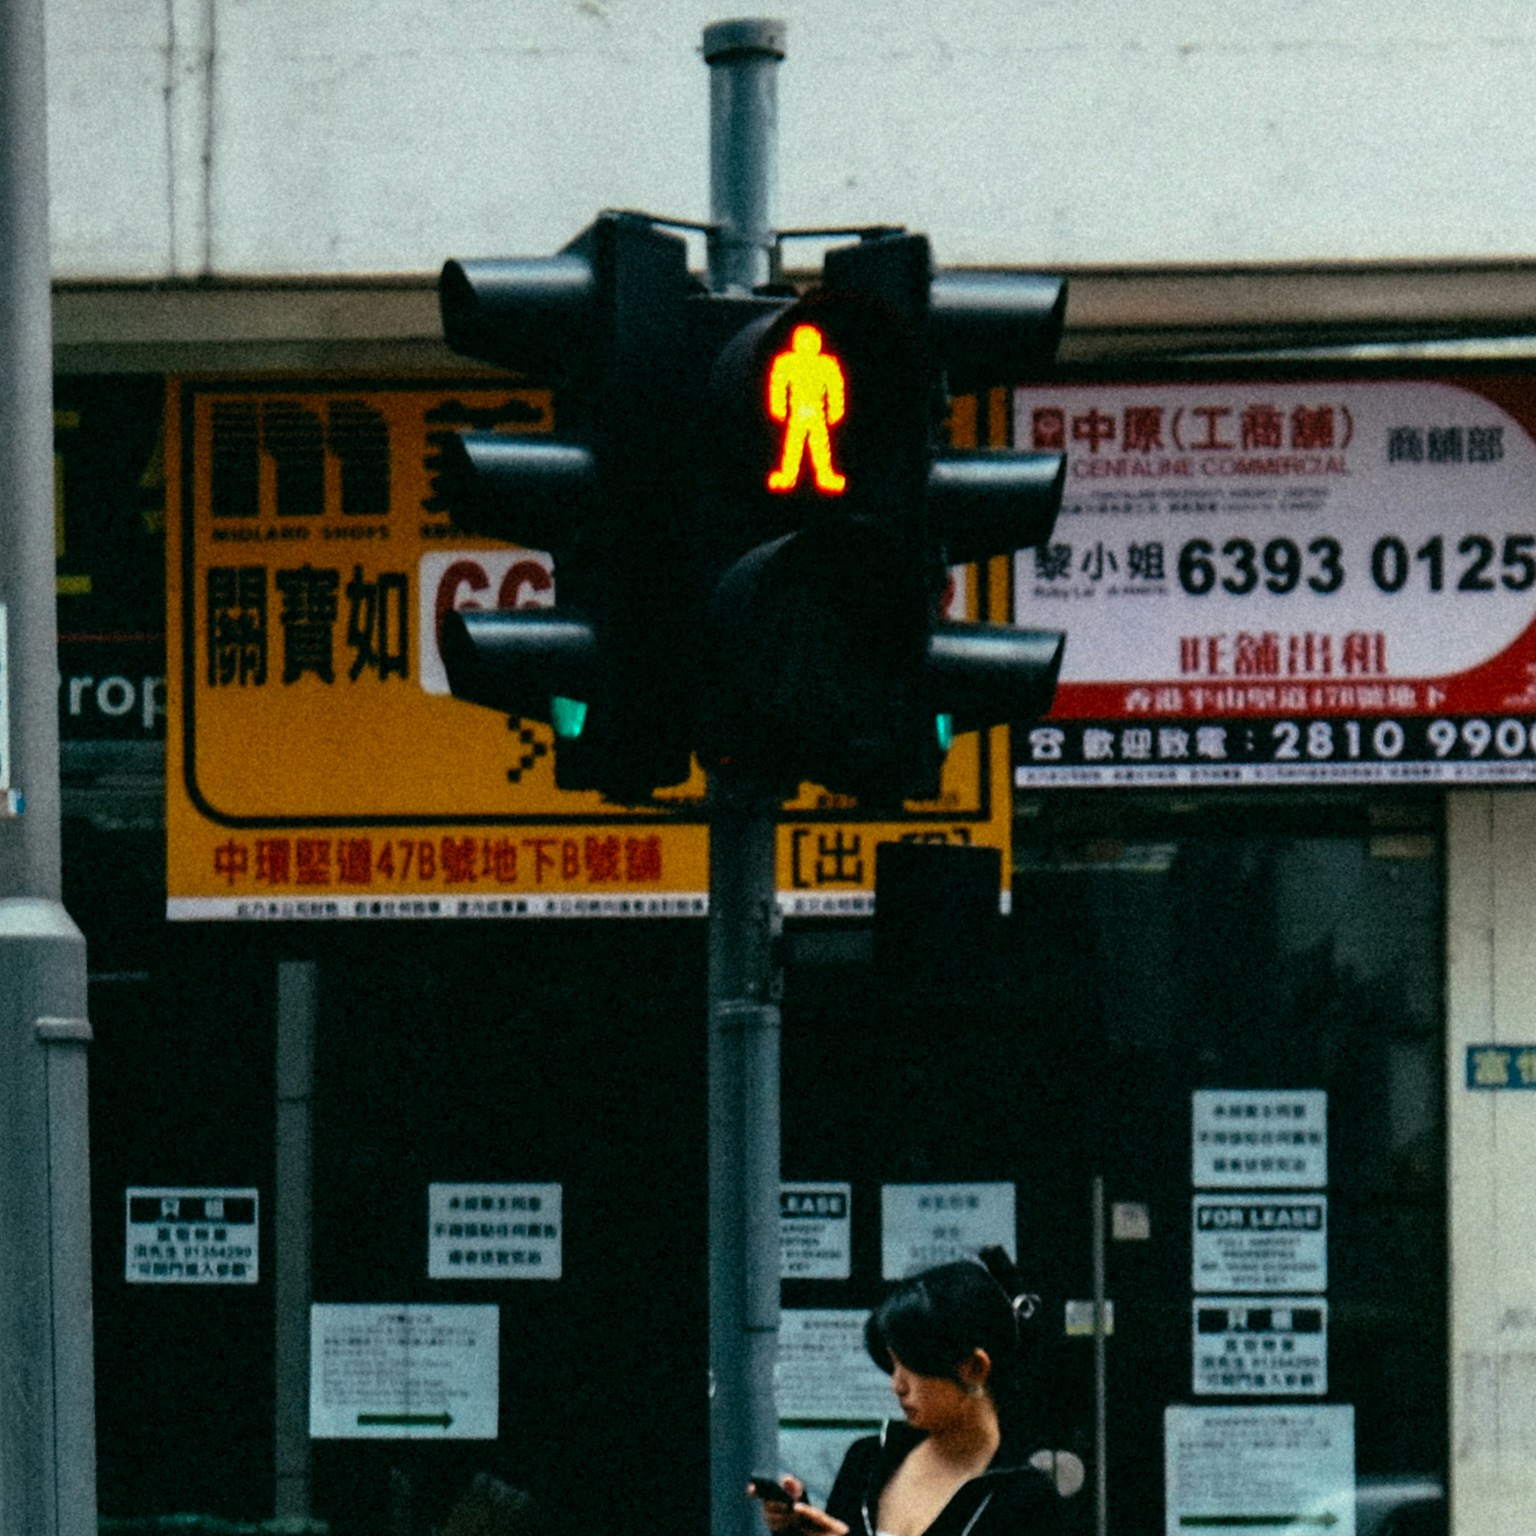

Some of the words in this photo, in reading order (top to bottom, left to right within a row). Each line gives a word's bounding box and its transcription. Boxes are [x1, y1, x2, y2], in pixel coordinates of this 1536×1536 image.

[1072, 456, 1194, 481] CENTALINE
[1201, 454, 1350, 478] COMMERCIAL
[211, 525, 310, 543] MIDLAND
[1177, 537, 1345, 597] 6393
[1179, 631, 1388, 677] 旺舖出租
[1271, 721, 1406, 759] 2810
[1200, 1208, 1244, 1228] FOR
[1249, 1208, 1318, 1228] LEASE
